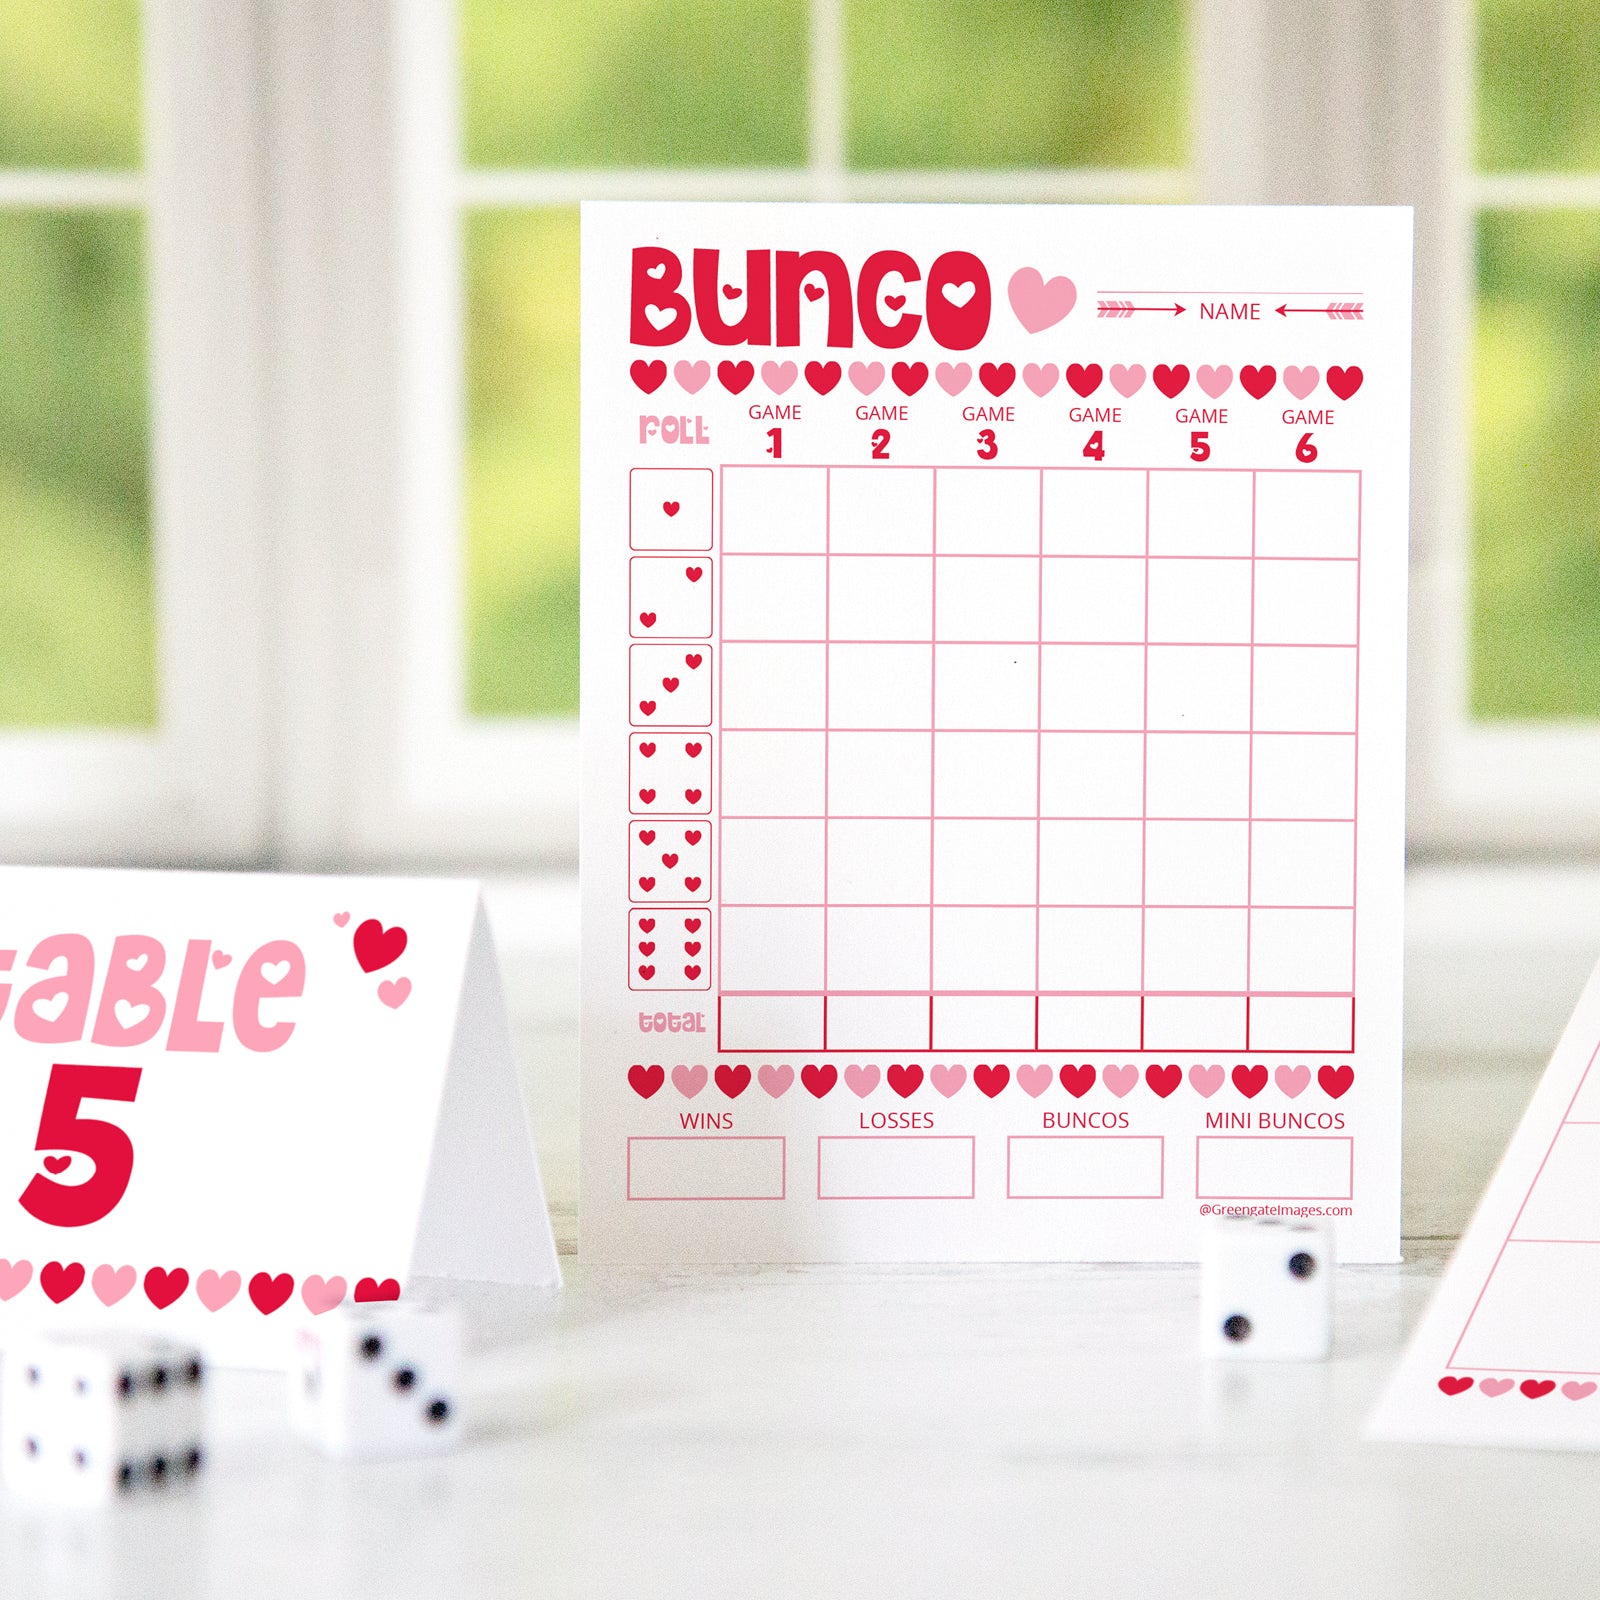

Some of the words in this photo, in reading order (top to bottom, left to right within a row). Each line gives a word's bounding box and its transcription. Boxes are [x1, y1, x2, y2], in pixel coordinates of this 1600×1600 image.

[1200, 303, 1261, 320] NAME
[749, 405, 801, 420] GAME
[856, 406, 909, 420] GAME
[962, 407, 1015, 421] GAME
[1069, 408, 1122, 422] GAME
[1175, 408, 1228, 423] GAME
[1282, 410, 1335, 425] GAME
[766, 428, 783, 459] 1
[871, 428, 892, 460] 2
[976, 429, 999, 461] 3
[1082, 430, 1106, 462] 4
[1190, 431, 1212, 463] 5
[1295, 433, 1319, 464] 6
[679, 1112, 734, 1130] WINS
[859, 1112, 935, 1130] LOSSES
[1042, 1112, 1130, 1129] BUNCOS
[1205, 1112, 1251, 1129] MINI
[1258, 1112, 1345, 1130] BUNCOS
[18, 1063, 144, 1228] 5
